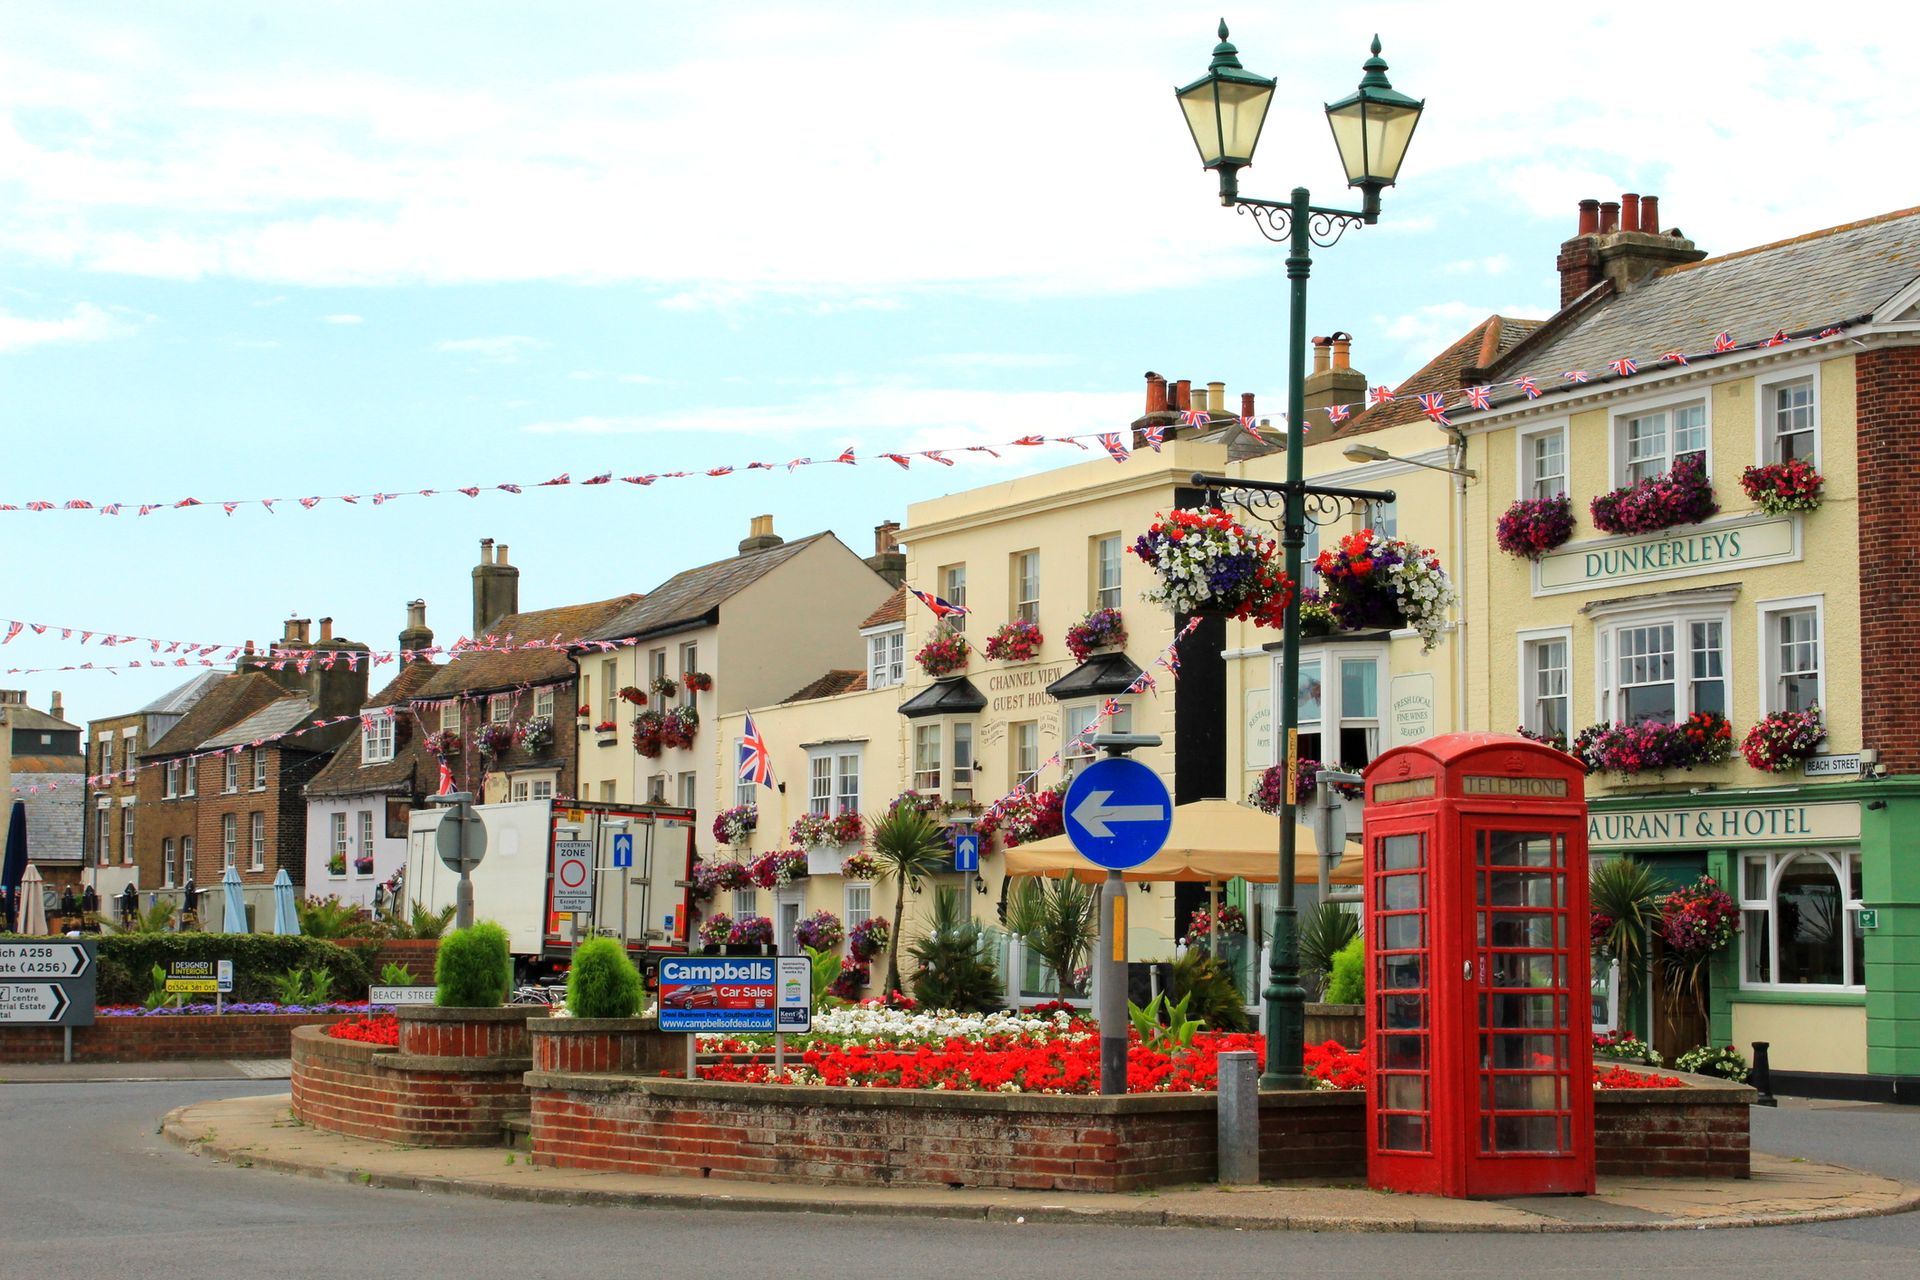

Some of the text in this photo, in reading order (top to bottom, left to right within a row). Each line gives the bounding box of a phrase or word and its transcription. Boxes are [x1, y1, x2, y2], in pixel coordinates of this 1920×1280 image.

[1585, 531, 1741, 578] DUNKERLEYS
[989, 667, 1063, 691] CHANNEL VIEW
[993, 694, 1025, 712] GUEST
[1394, 696, 1430, 710] FRESH LOCAL
[1248, 708, 1270, 728] RESTAU
[1396, 711, 1428, 722] FINE WINES
[1400, 726, 1426, 736] SEAFOOD
[1256, 738, 1270, 748] HOTE
[1807, 759, 1859, 771] BEACH STREET
[1467, 776, 1564, 796] TELEPHONE
[1588, 808, 1812, 840] AURANT & HOTEL
[20, 948, 53, 958] A258
[20, 962, 67, 973] (A256)
[663, 962, 772, 982] Campbells
[373, 991, 434, 999] BEACH STREE
[720, 986, 773, 998] Car Sales
[662, 1018, 772, 1029] www.campbellsofdeal.co.uk
